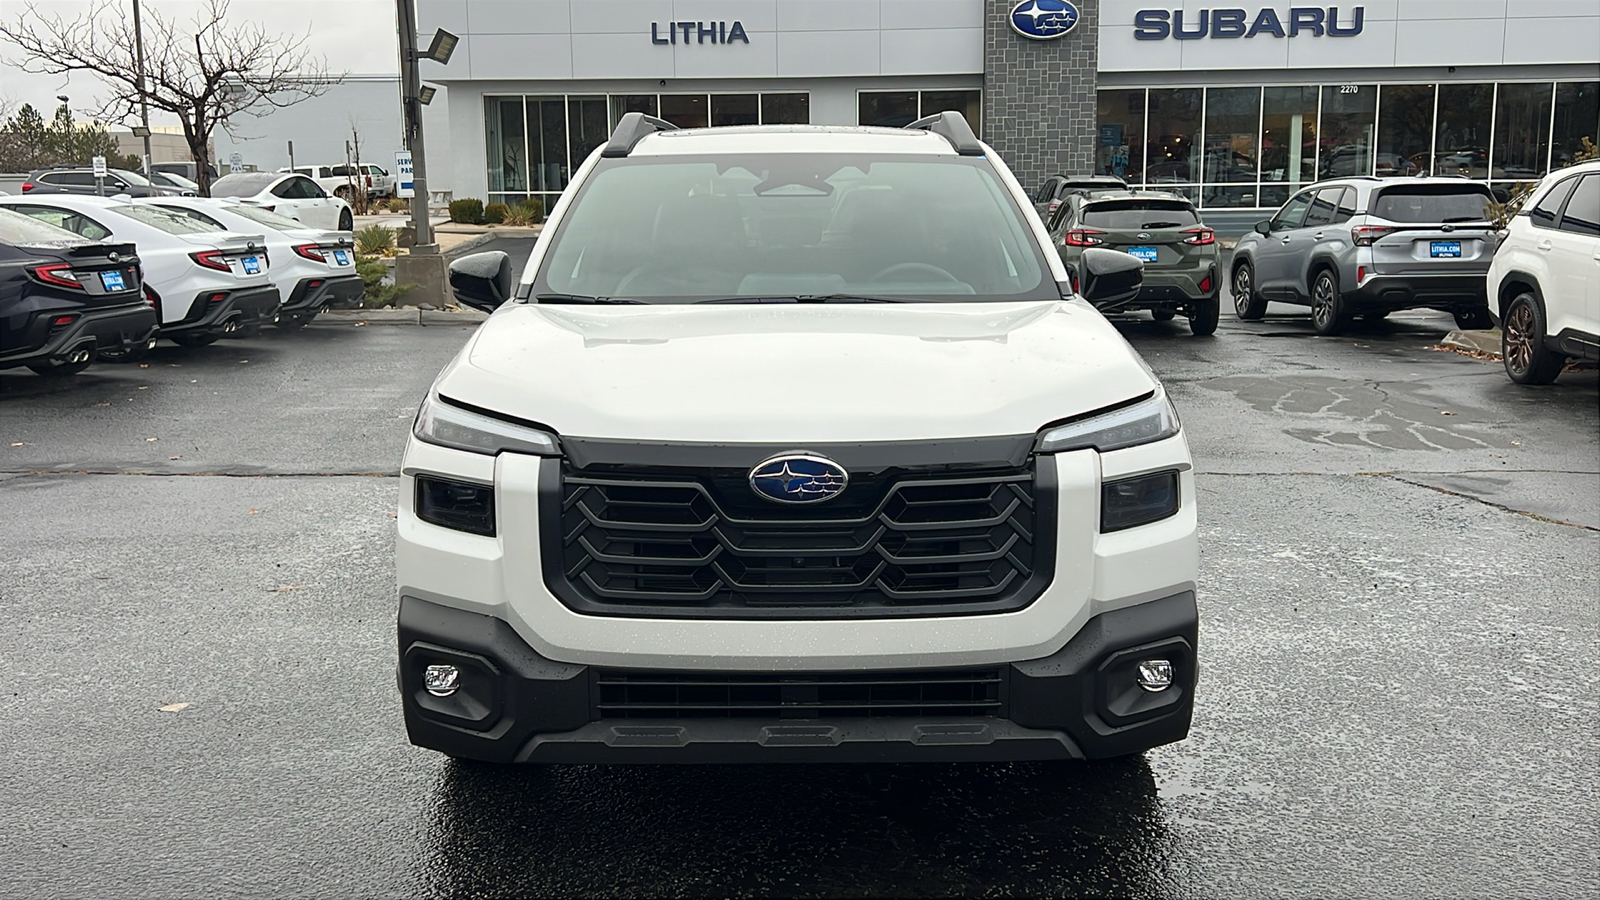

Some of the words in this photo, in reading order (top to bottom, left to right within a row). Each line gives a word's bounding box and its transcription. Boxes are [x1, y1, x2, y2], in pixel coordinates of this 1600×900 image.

[1134, 6, 1365, 40] SUBARU
[651, 21, 750, 45] LITHIA
[1340, 85, 1358, 94] 2270
[397, 158, 413, 166] SERV
[1431, 245, 1461, 253] LITHIA.COM
